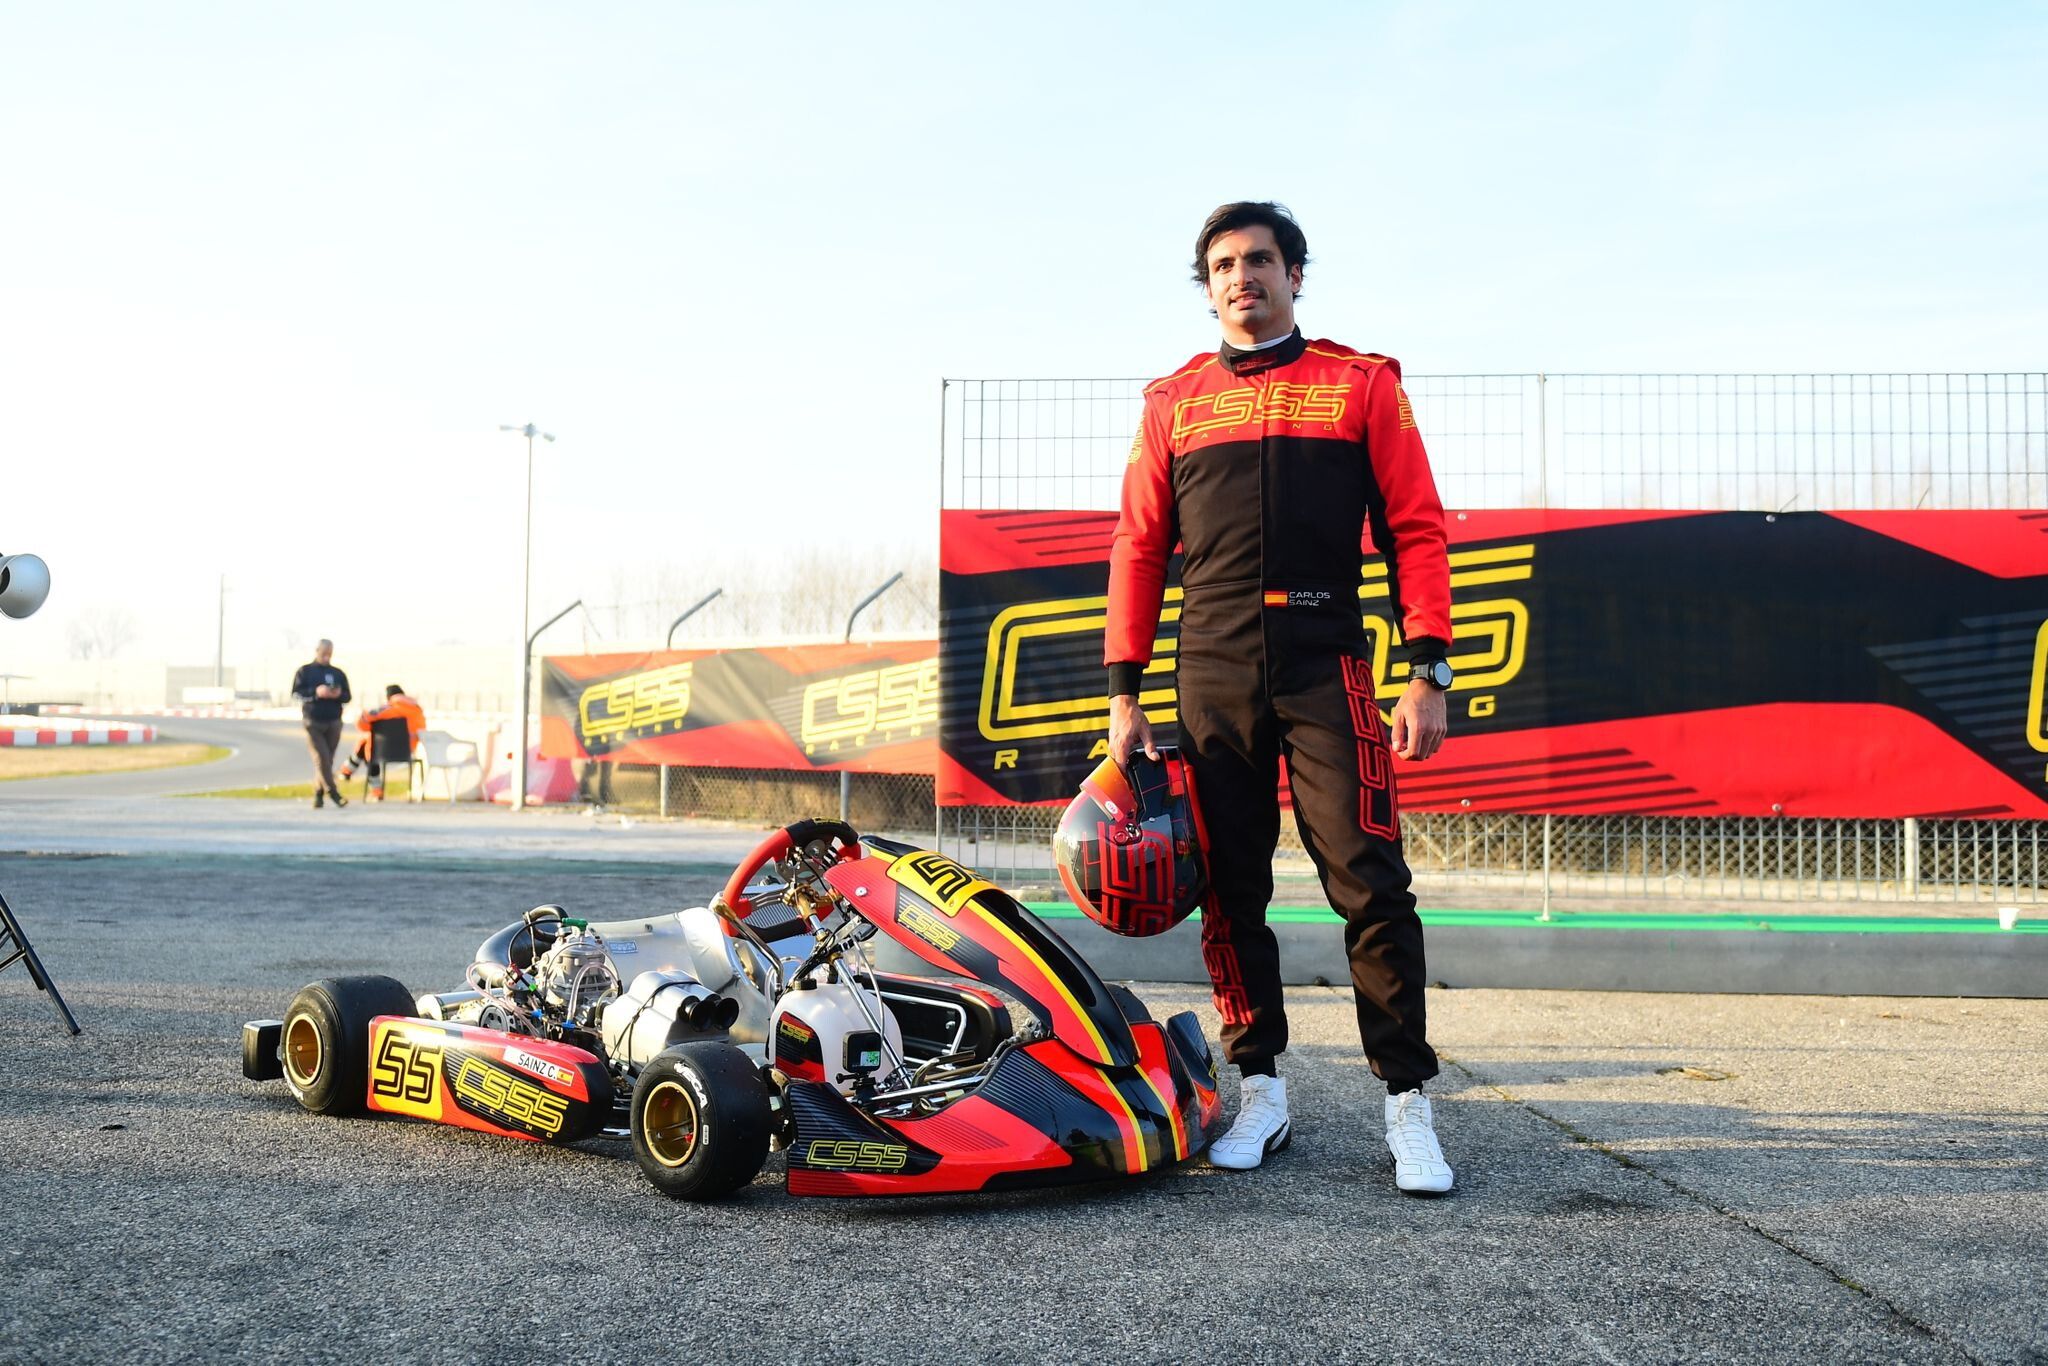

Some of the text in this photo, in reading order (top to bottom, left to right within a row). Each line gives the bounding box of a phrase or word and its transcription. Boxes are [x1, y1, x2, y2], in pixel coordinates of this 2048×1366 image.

[1288, 591, 1331, 599] CARLOS
[1288, 599, 1320, 607] SAINZ
[805, 724, 922, 755] RACIN
[374, 1029, 442, 1105] 55
[518, 1053, 556, 1079] SAINZ C.
[456, 1057, 569, 1133] CS55
[806, 1140, 908, 1168] CS55
